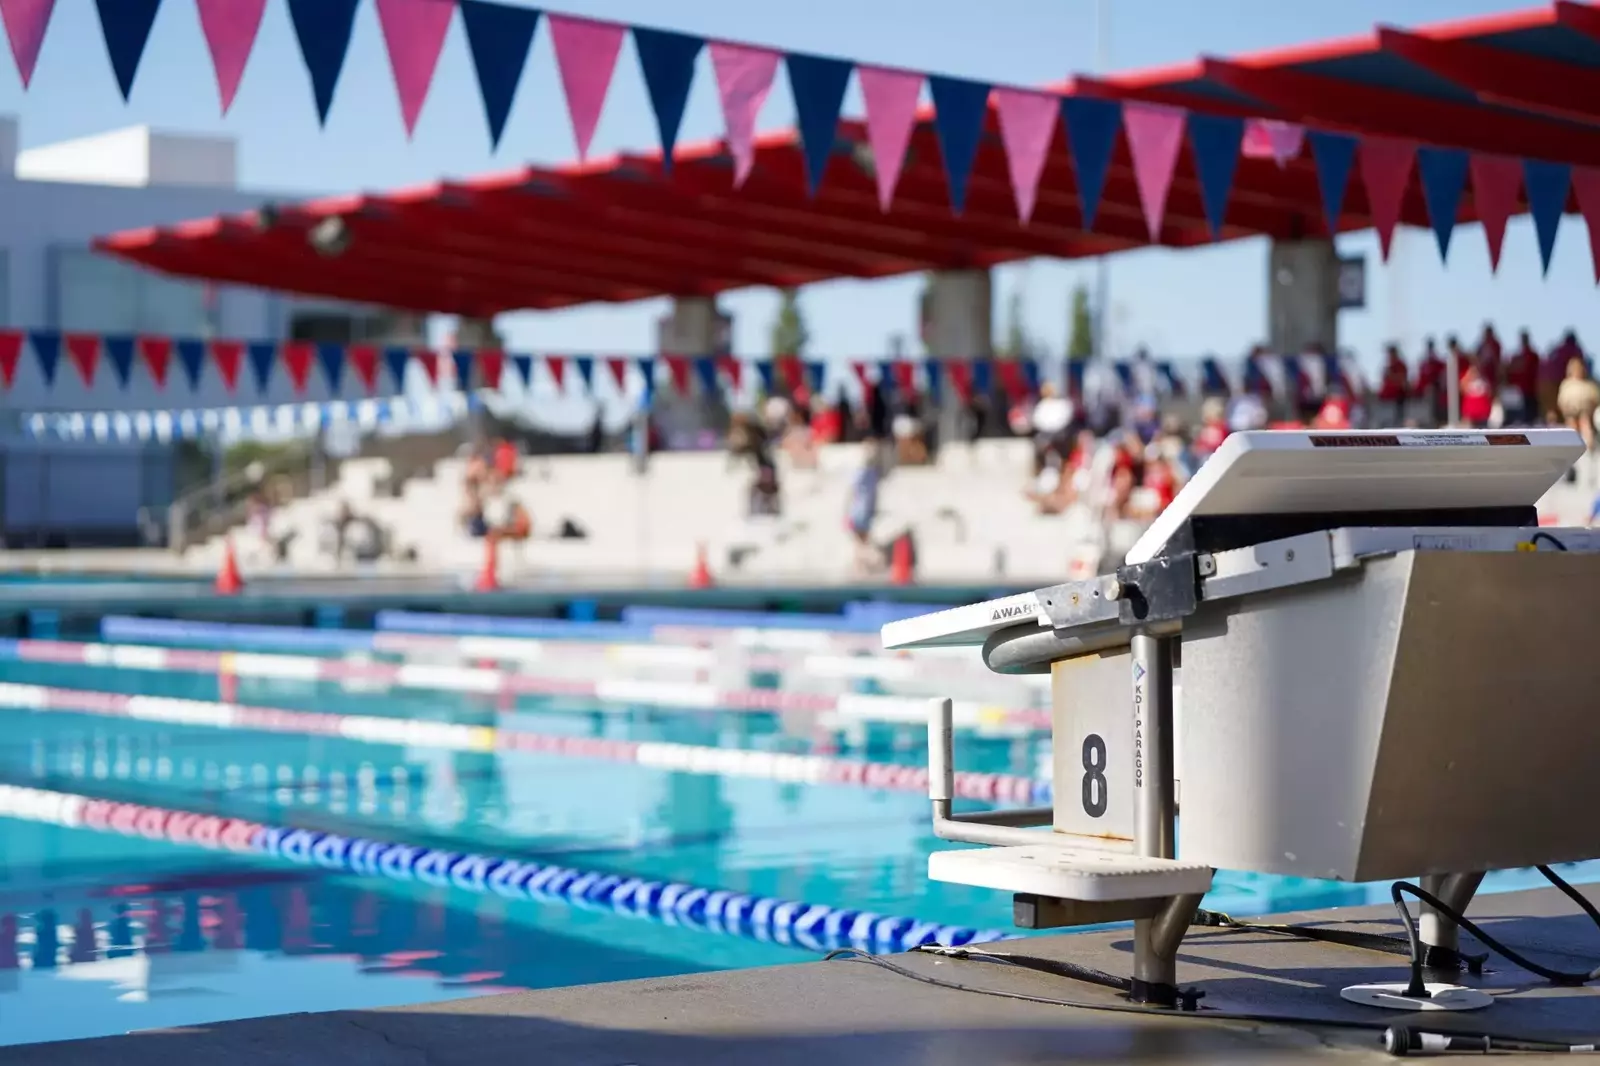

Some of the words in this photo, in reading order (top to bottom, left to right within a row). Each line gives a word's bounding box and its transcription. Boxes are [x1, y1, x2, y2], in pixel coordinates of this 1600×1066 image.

[1135, 685, 1143, 714] KDI
[1082, 734, 1107, 818] 8
[1135, 720, 1143, 787] PARAGON
